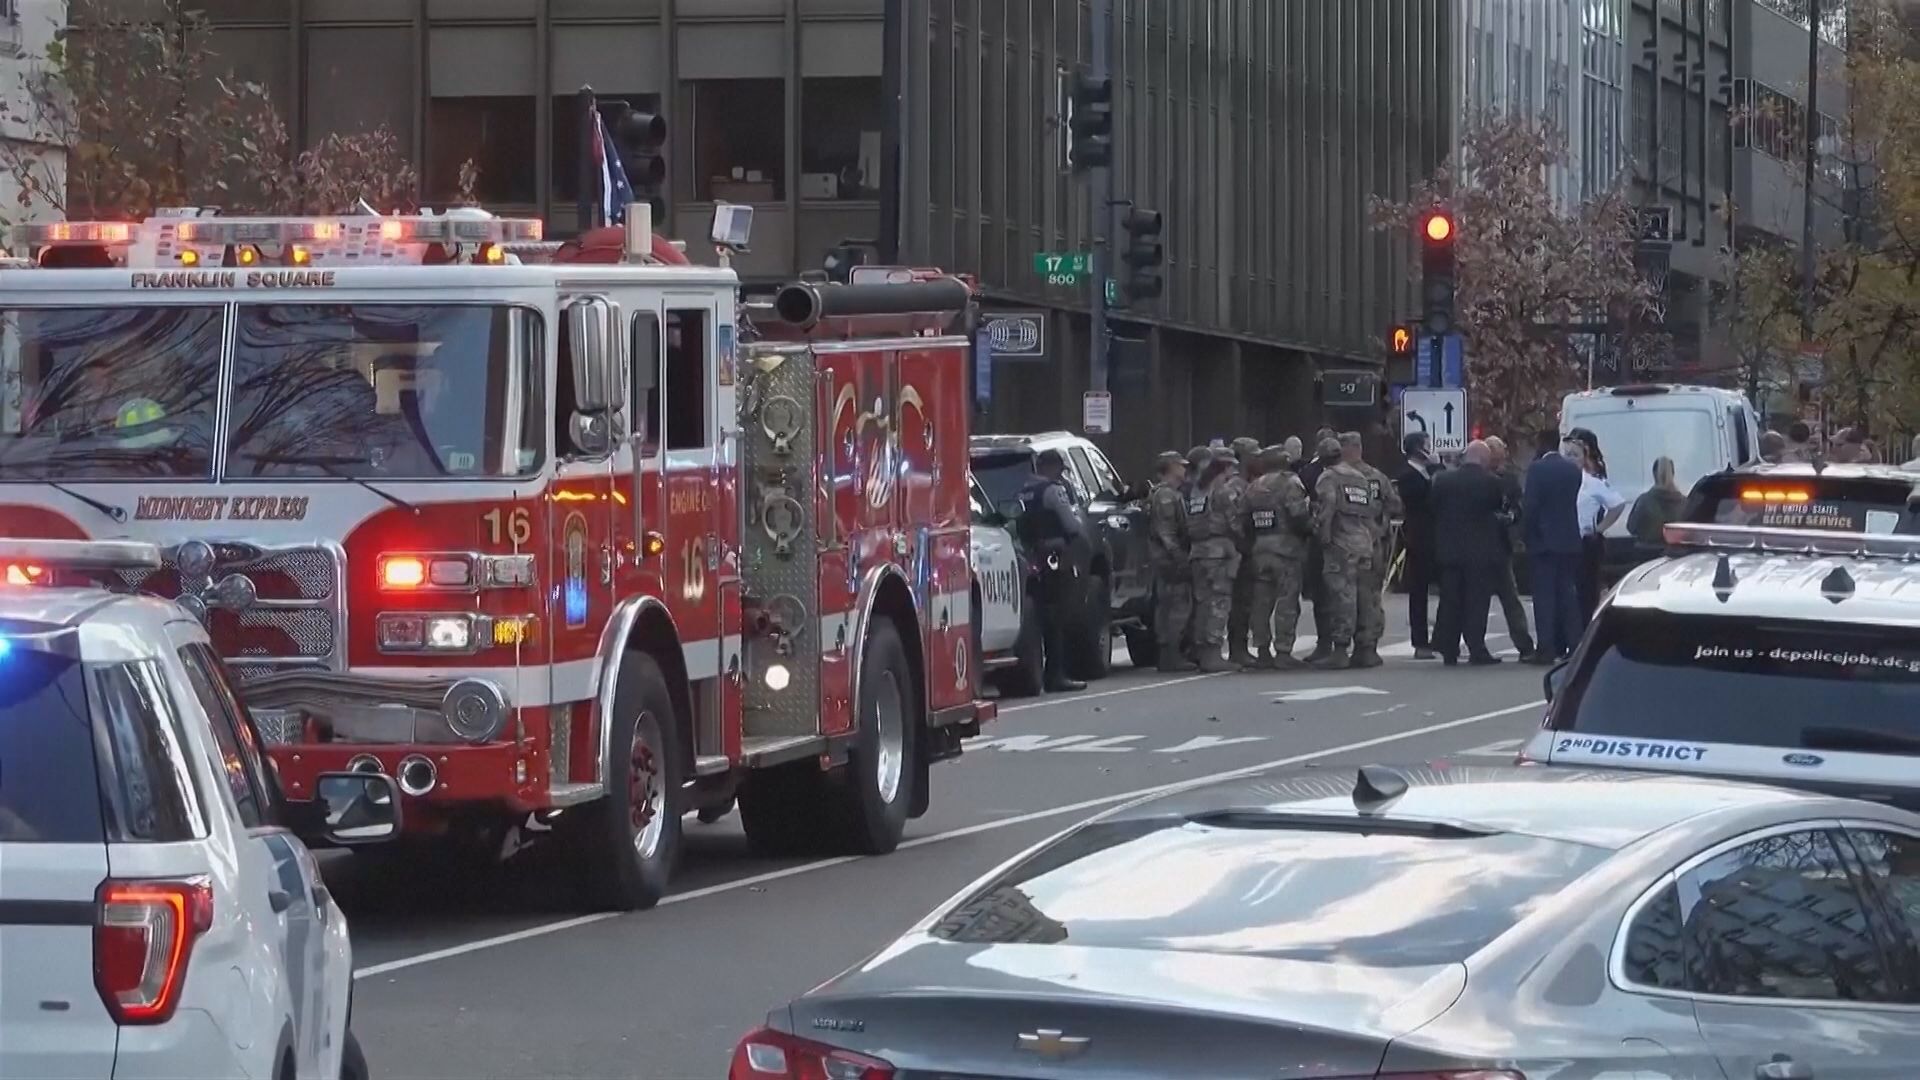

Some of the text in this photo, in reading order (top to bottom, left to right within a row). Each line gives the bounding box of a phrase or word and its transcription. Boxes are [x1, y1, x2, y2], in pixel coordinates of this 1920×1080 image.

[1045, 257, 1063, 272] 17
[131, 271, 336, 288] FRANKLIN SQUARE
[1048, 273, 1075, 286] 800
[1435, 438, 1462, 448] ONLY
[134, 496, 309, 520] MIDNIGHT EXPRESS
[1764, 503, 1839, 515] THE UNITED STATES
[484, 507, 531, 545] 16
[1763, 515, 1852, 528] SECRET SERVICE
[682, 536, 705, 600] 16
[1694, 645, 1729, 659] Join
[1734, 649, 1753, 658] us
[1591, 740, 1708, 761] DISTRICT
